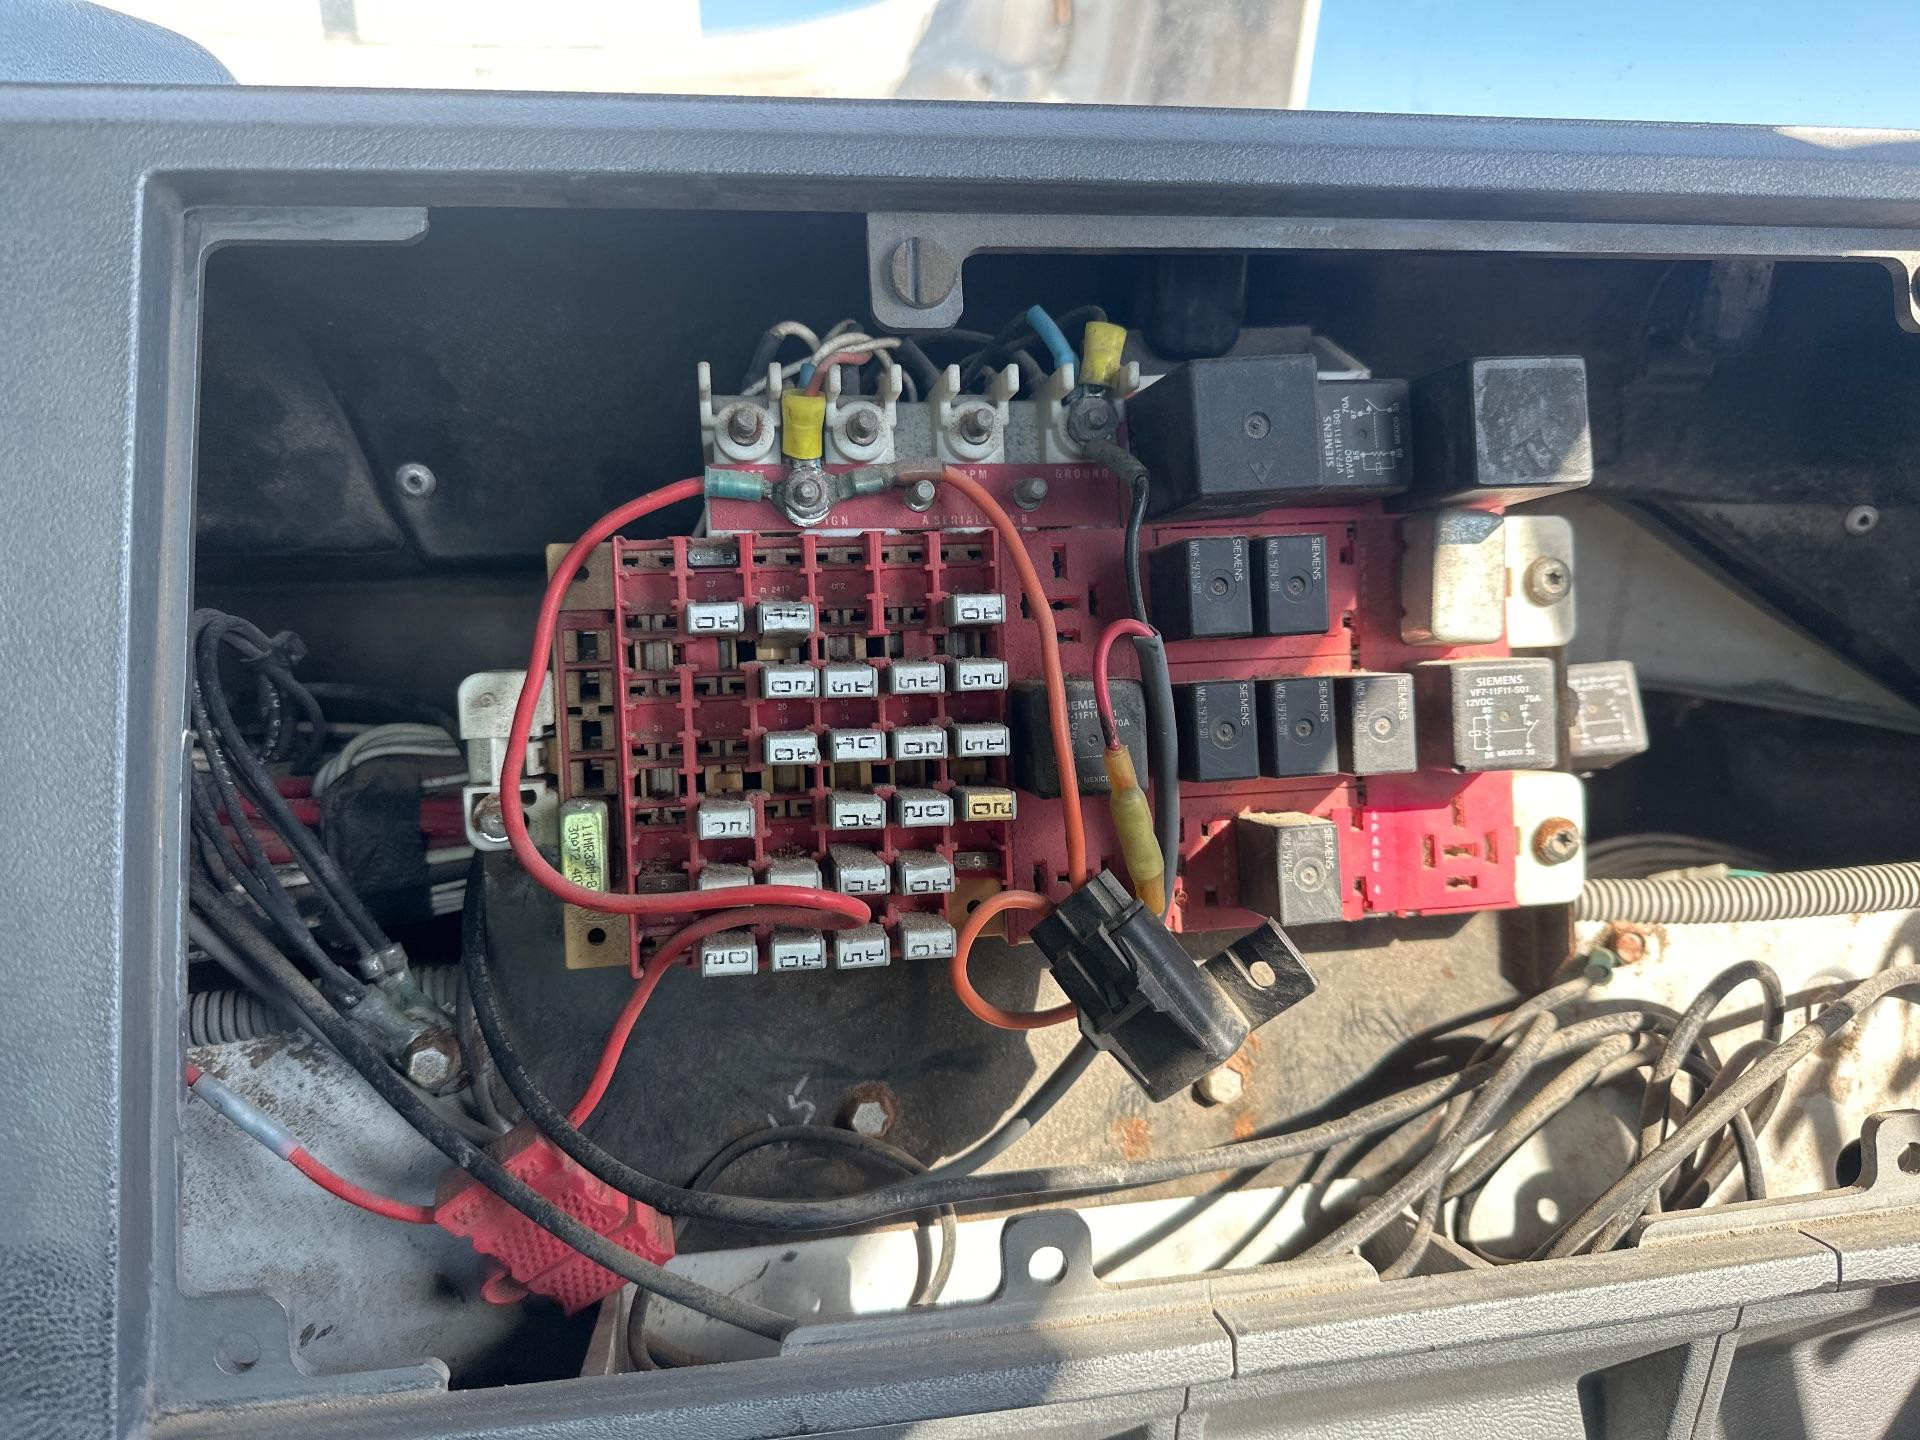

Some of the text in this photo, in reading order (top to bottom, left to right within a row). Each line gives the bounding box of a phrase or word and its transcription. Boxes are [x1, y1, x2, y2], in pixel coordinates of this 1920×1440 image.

[1323, 416, 1335, 468] SIEMENS
[1341, 395, 1355, 479] 12VDC 70A
[825, 516, 849, 526] IGN
[933, 514, 981, 525] SERIAL
[1232, 538, 1244, 582] SIEMENS
[1311, 537, 1322, 580] SIEMENS
[1318, 681, 1329, 724] SIEMENS
[1397, 678, 1408, 721] SIEMENS
[1465, 694, 1542, 707] 12VDC 70A
[1469, 685, 1530, 697] VF7-11F11-S01
[1475, 675, 1523, 687] SIEMENS
[1239, 683, 1250, 727] SIEMENS
[973, 856, 981, 867] 5
[1323, 827, 1335, 870] SIEMENS
[1370, 811, 1380, 872] SPARE
